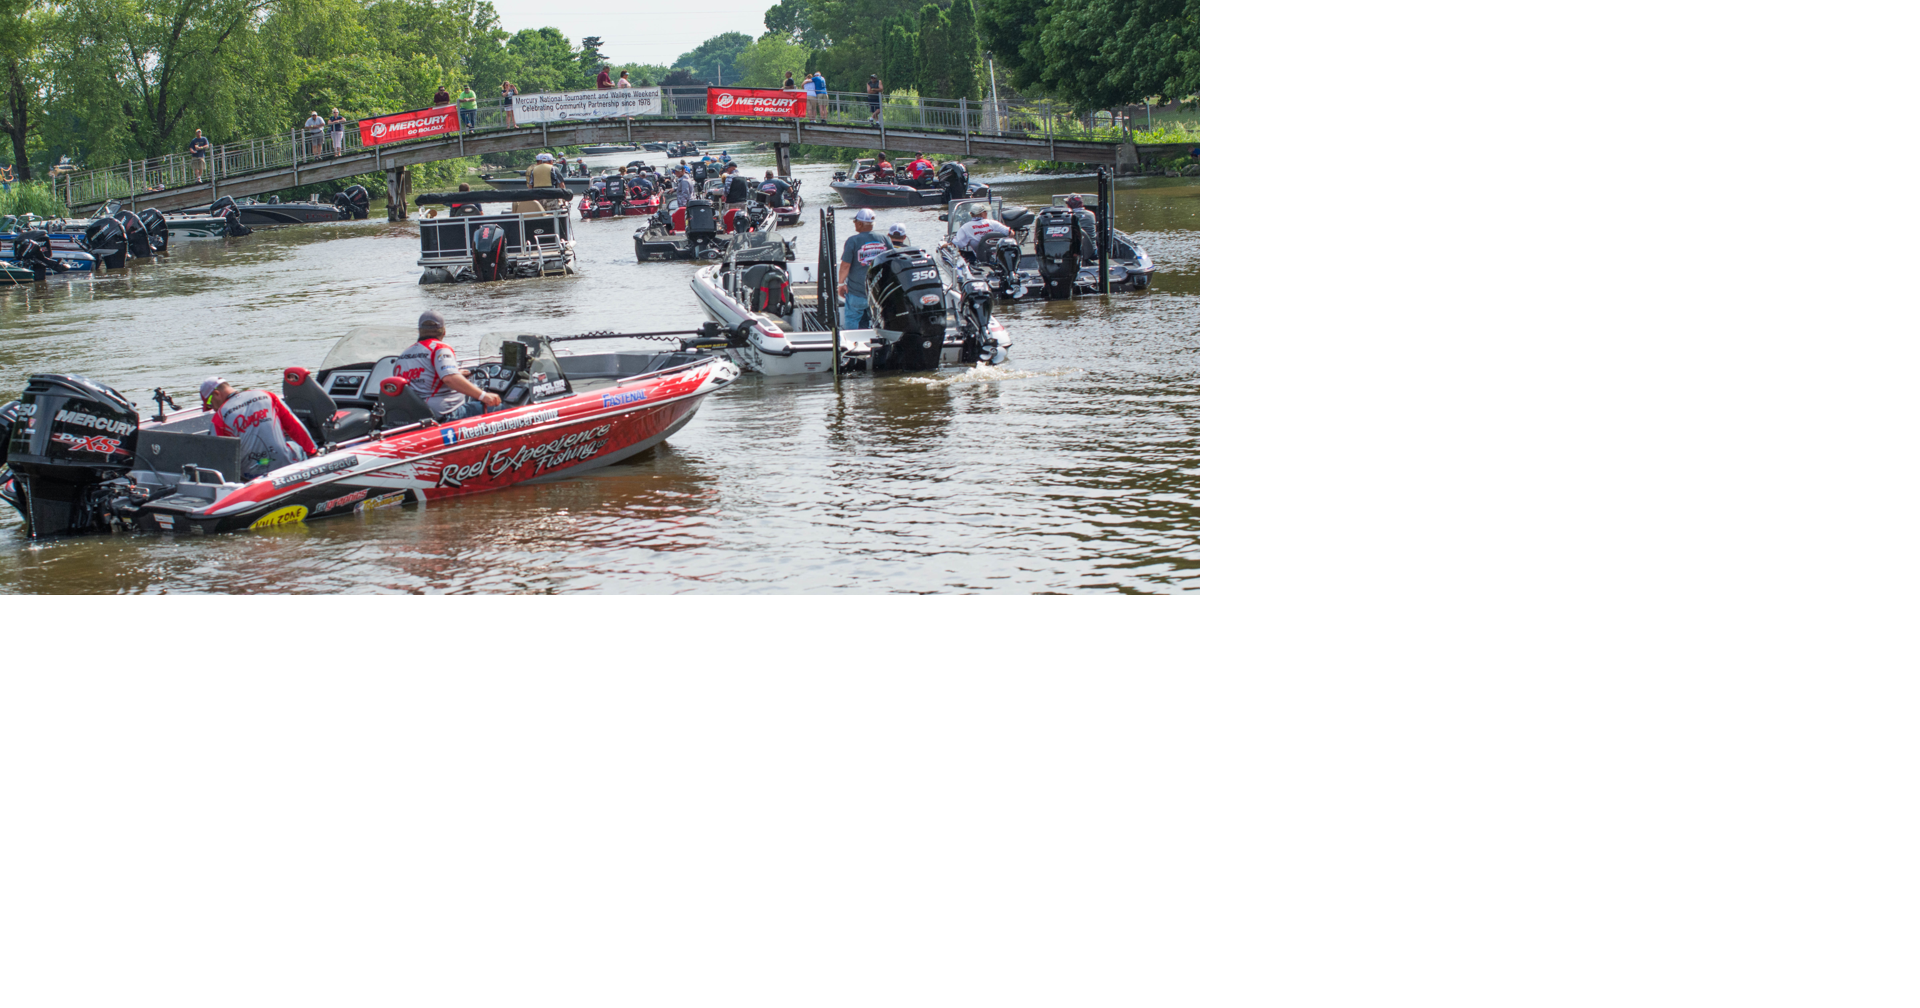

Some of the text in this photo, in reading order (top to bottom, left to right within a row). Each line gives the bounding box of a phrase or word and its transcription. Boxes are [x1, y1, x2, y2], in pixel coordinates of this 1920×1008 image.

[515, 97, 538, 105] Mercury
[540, 95, 563, 103] National
[564, 93, 597, 101] Tournament
[633, 90, 659, 98] Weekend
[522, 103, 553, 112] Celebrating
[555, 101, 586, 110] Community
[588, 100, 619, 108] Partnership
[638, 98, 651, 106] 1978
[735, 97, 798, 107] MERCURY
[389, 114, 449, 132] MERCURY
[1046, 226, 1070, 235] 250
[911, 270, 937, 282] 350
[602, 389, 648, 408] FASTENAL
[55, 409, 137, 437] MERCURY
[233, 408, 269, 433] Ranger
[535, 440, 598, 474] Fishing
[272, 465, 326, 486] Ranger
[439, 450, 491, 486] Reel
[277, 508, 303, 524] ZONE
